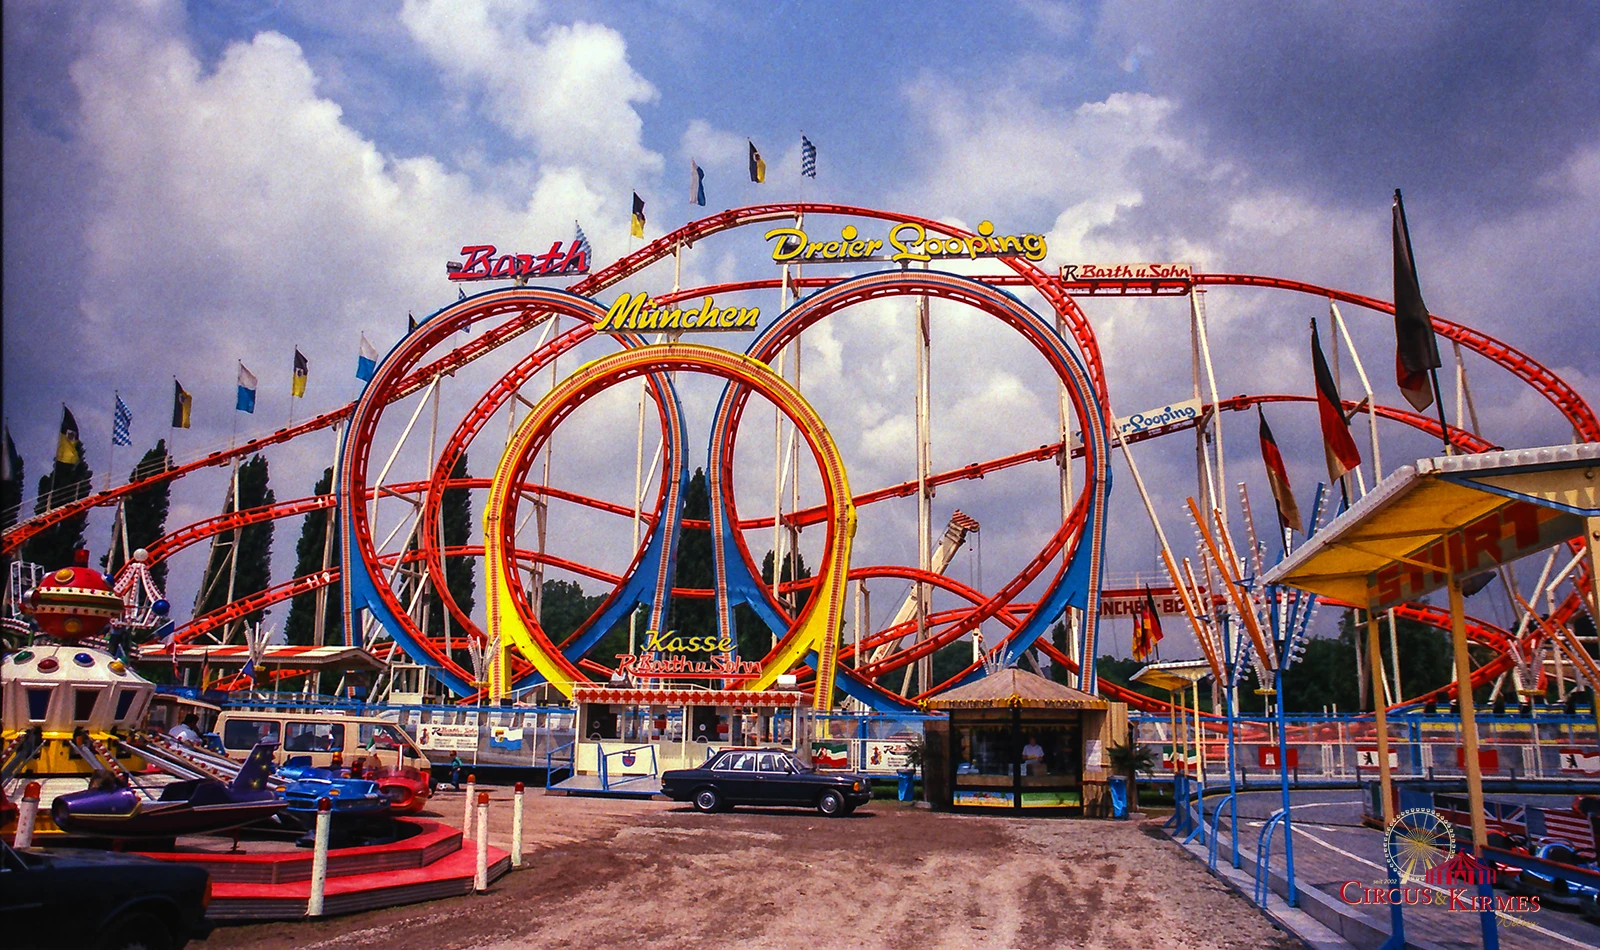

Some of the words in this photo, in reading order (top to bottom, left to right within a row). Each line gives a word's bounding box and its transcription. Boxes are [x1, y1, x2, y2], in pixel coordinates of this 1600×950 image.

[448, 240, 590, 279] Barth
[764, 227, 883, 261] Dreier
[889, 222, 1047, 262] Looping
[593, 291, 760, 331] München
[1129, 406, 1197, 434] Looping
[1376, 500, 1541, 605] START
[640, 630, 738, 652] Kasse
[709, 654, 763, 674] Sohn
